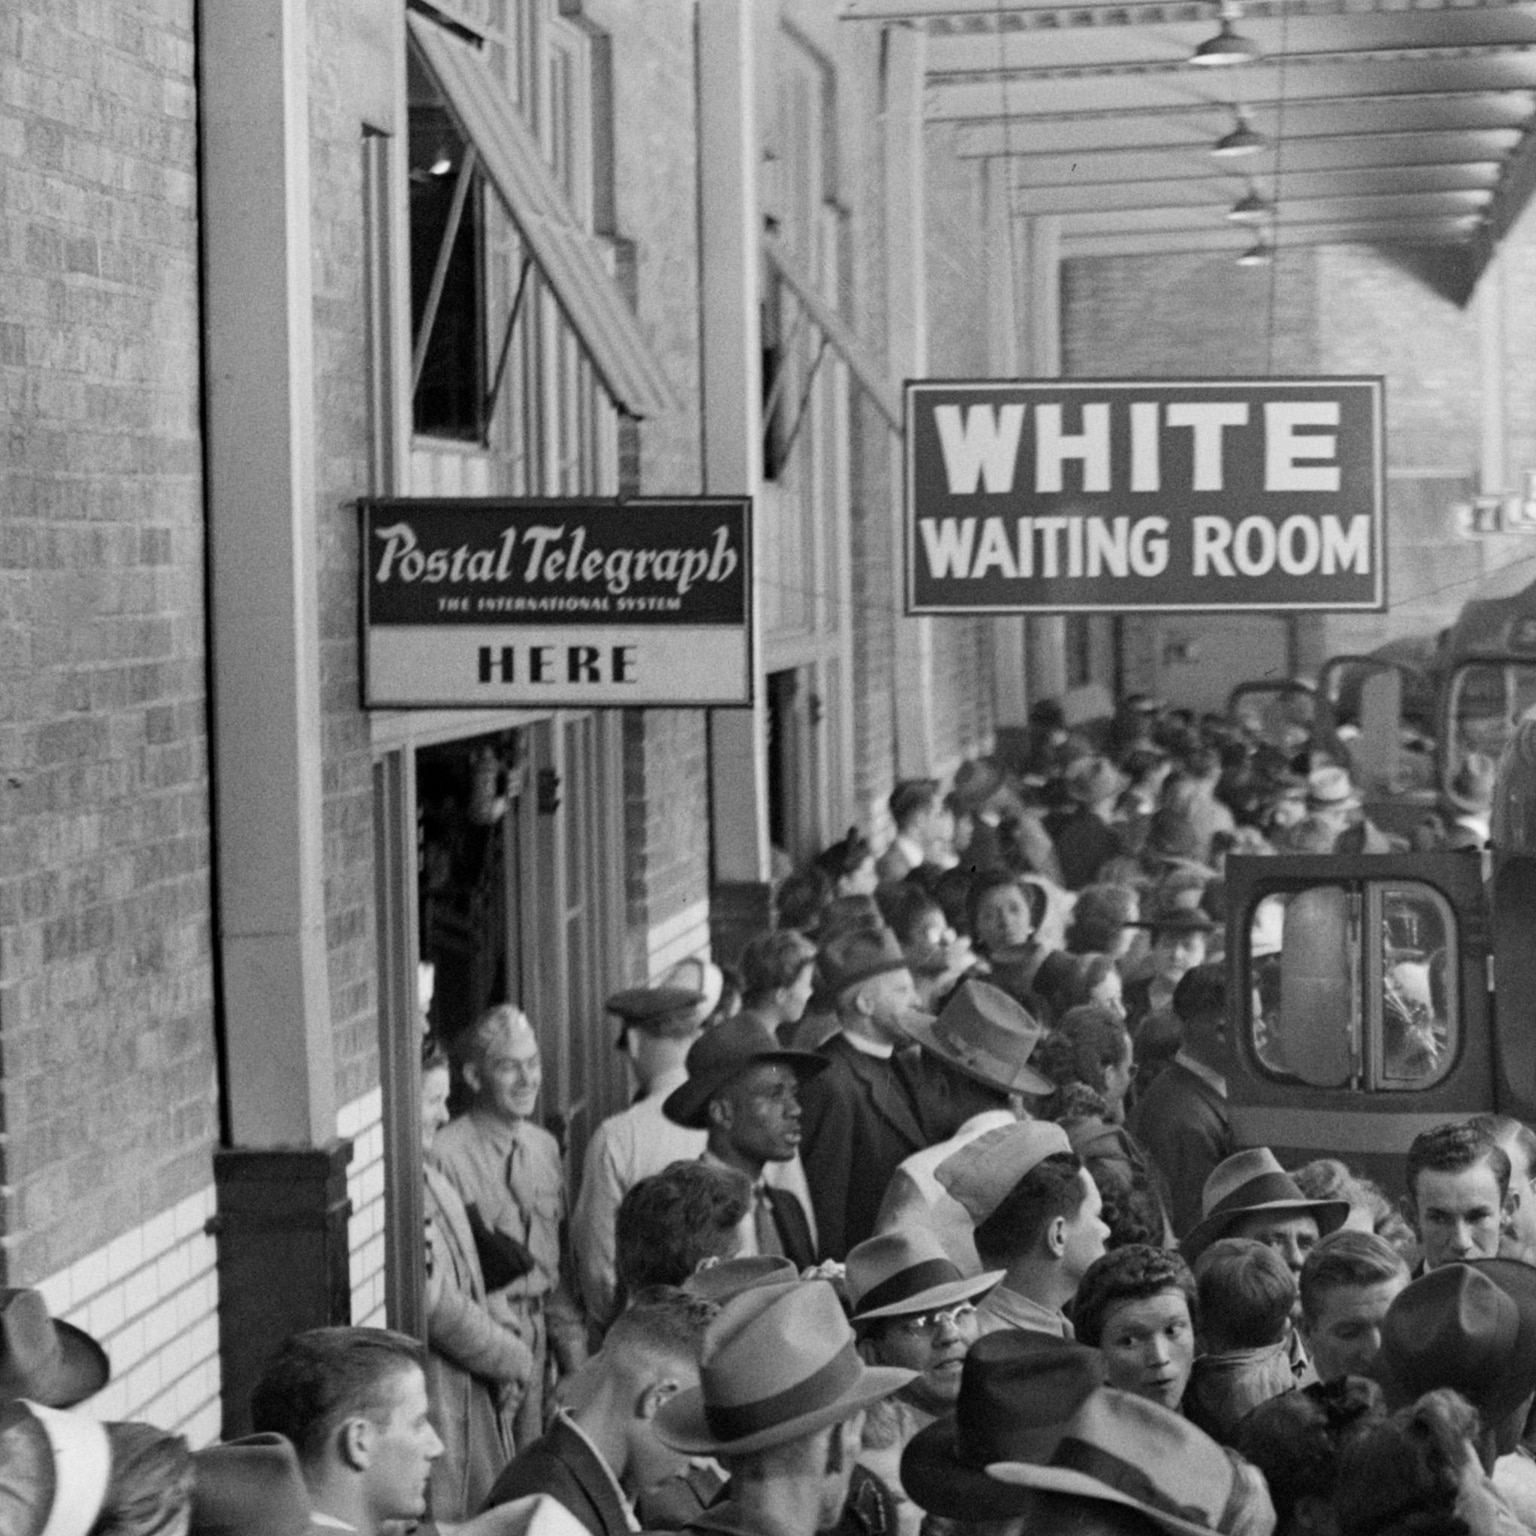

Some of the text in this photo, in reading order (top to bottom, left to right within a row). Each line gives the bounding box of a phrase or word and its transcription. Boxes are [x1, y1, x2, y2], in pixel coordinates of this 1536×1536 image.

[934, 401, 1341, 493] WHITE
[375, 522, 738, 595] Postal Telegraph
[920, 514, 1371, 579] WAITING ROOM
[438, 596, 682, 612] THE INTERNATIONAL SYSTEM
[478, 645, 637, 684] HERE
